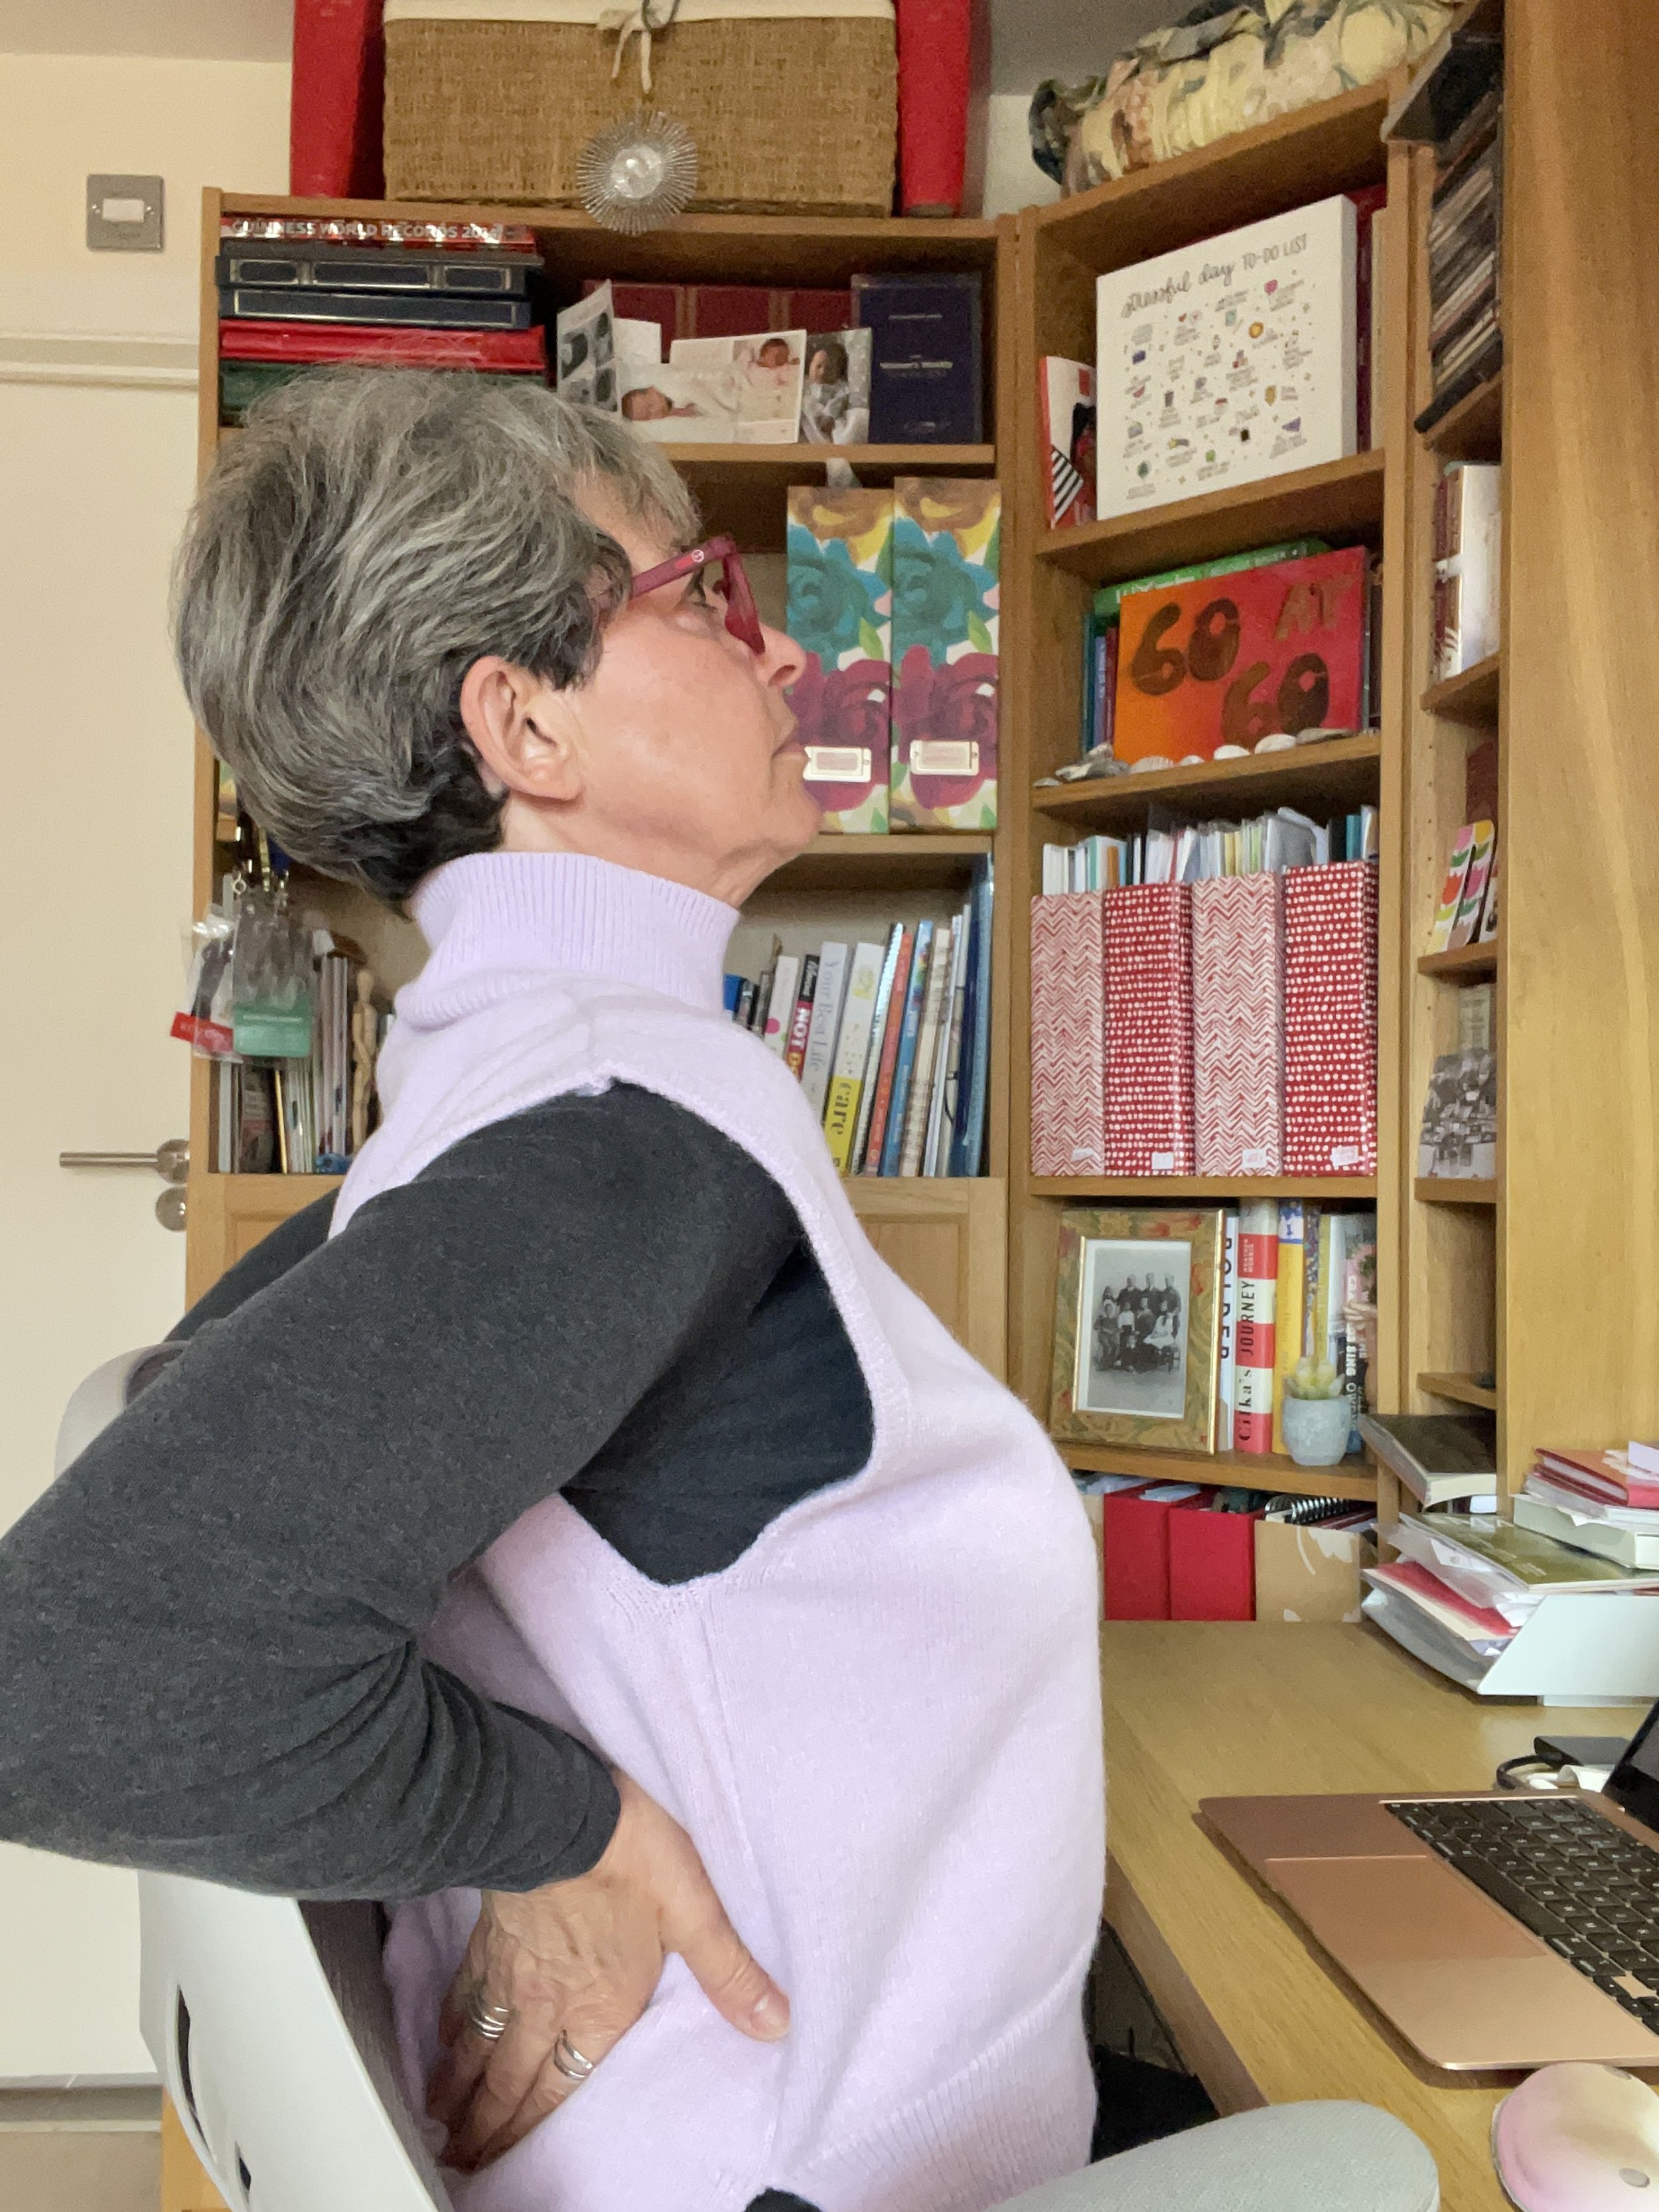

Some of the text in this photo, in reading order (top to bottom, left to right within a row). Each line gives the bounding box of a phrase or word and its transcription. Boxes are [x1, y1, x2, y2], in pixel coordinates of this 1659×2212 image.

[319, 222, 378, 237] WORLD
[380, 223, 458, 239] RECORDS
[1283, 233, 1307, 257] LIST
[1130, 597, 1242, 696] 60
[1220, 652, 1330, 751] 60
[790, 1007, 812, 1049] NOT
[1240, 1280, 1255, 1356] JOURNEY
[1346, 1345, 1357, 1376] SING
